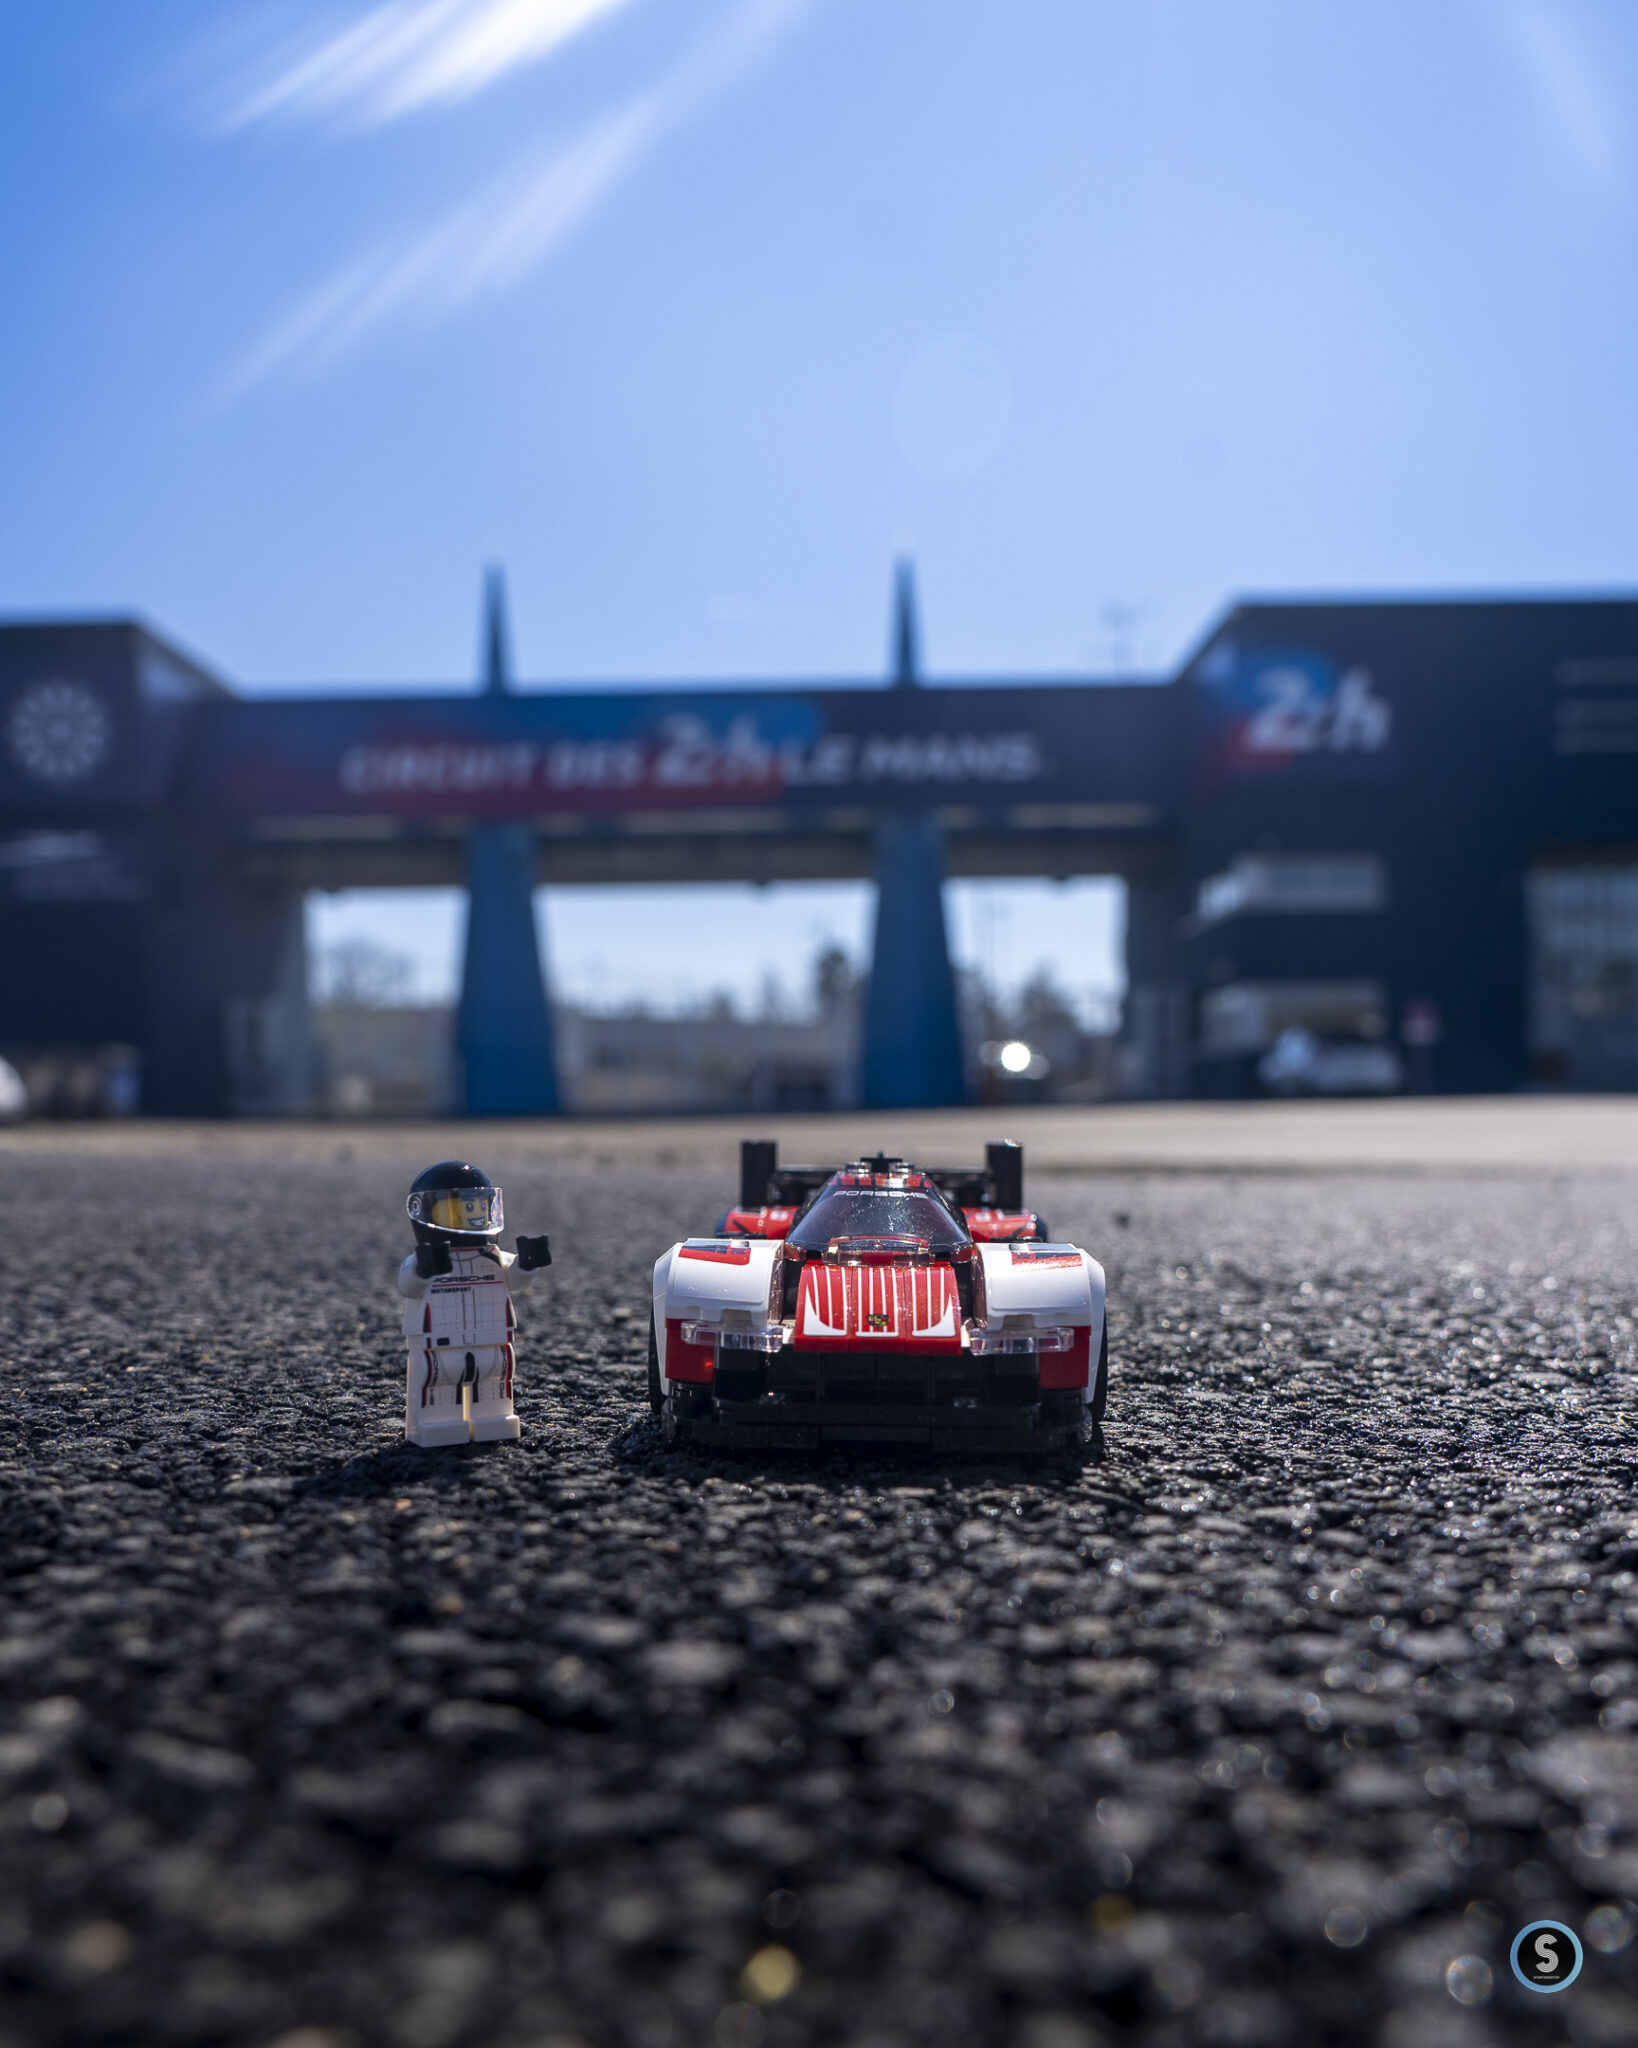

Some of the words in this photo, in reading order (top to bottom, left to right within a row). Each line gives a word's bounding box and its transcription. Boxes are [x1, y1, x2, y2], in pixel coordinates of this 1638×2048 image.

[341, 740, 536, 794] CIRCUIT
[544, 739, 644, 789] DES
[782, 736, 853, 785] LE
[861, 732, 1044, 784] MANS
[833, 1190, 929, 1199] PORSCHE
[431, 1286, 471, 1294] MOTORSPORT
